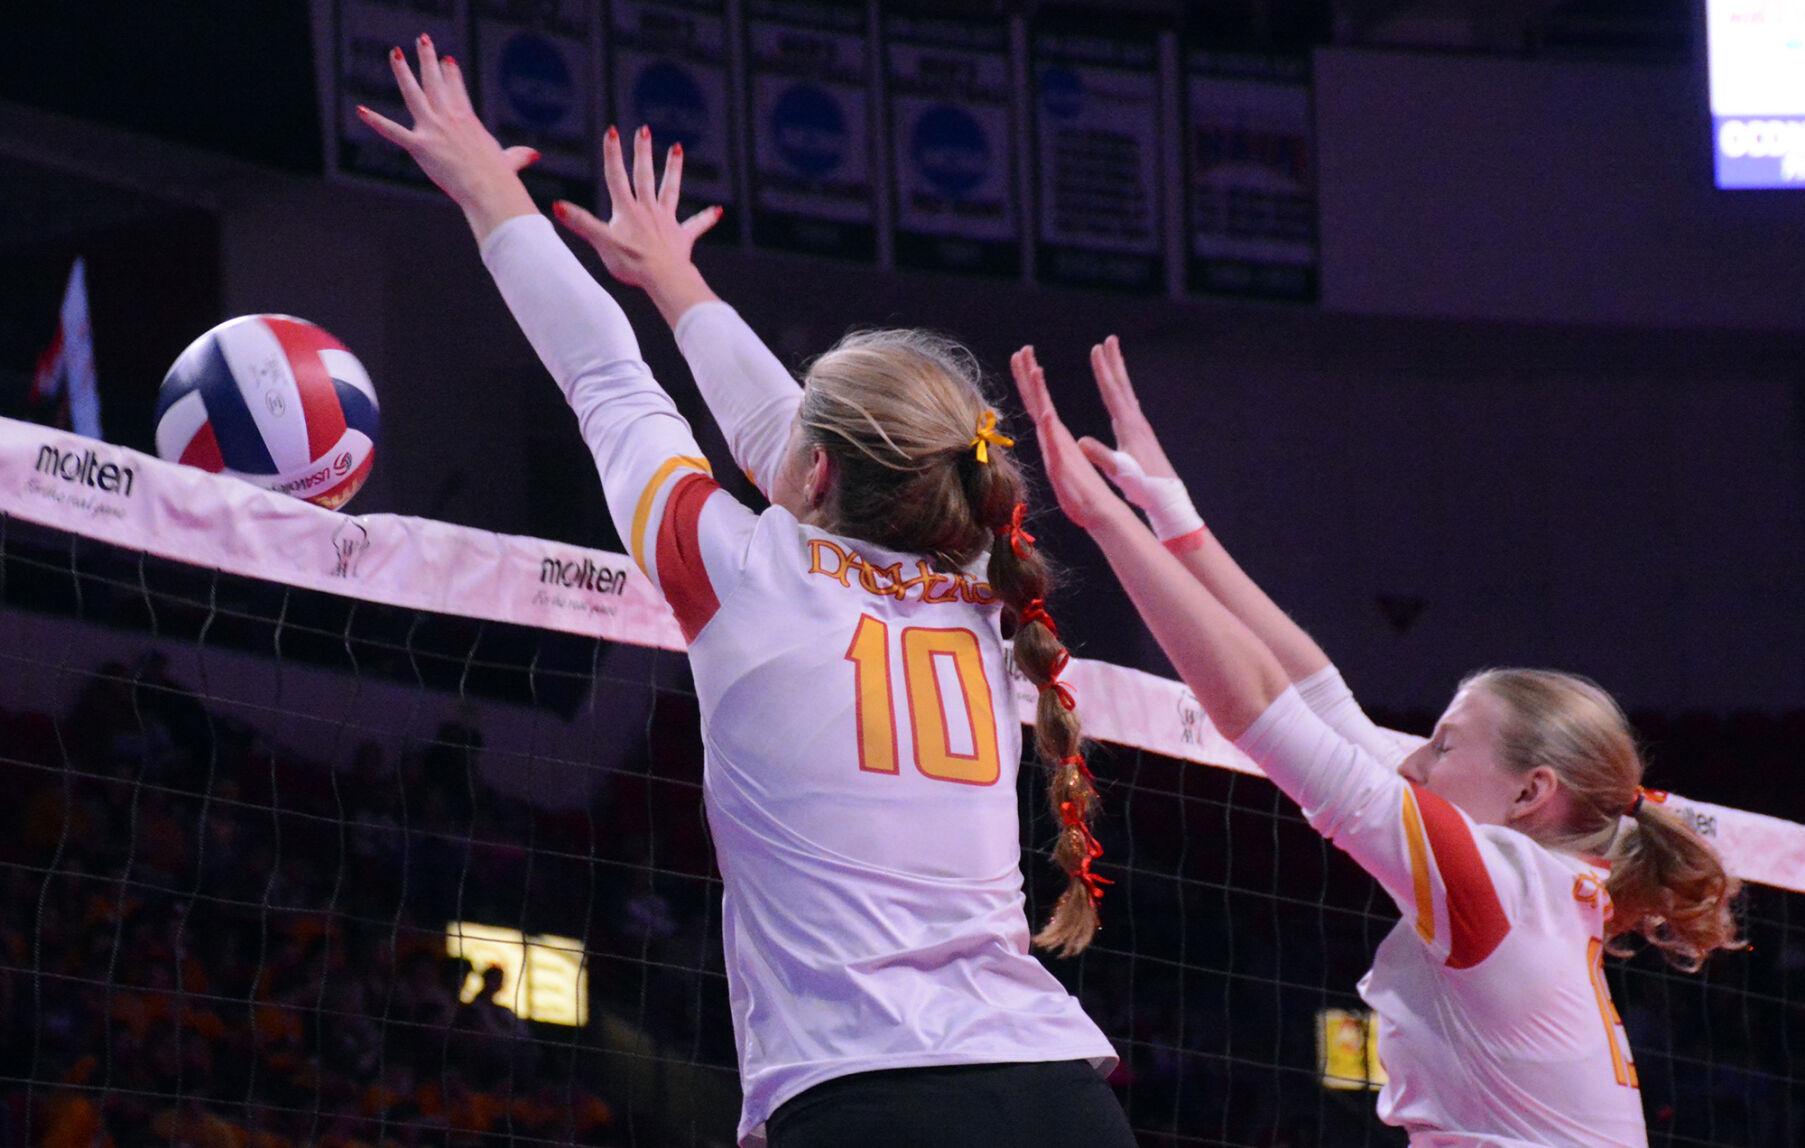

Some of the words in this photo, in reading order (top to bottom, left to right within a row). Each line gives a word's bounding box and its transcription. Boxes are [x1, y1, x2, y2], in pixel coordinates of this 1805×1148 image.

[36, 445, 134, 496] molten
[540, 557, 627, 595] molten
[844, 612, 1001, 787] 10
